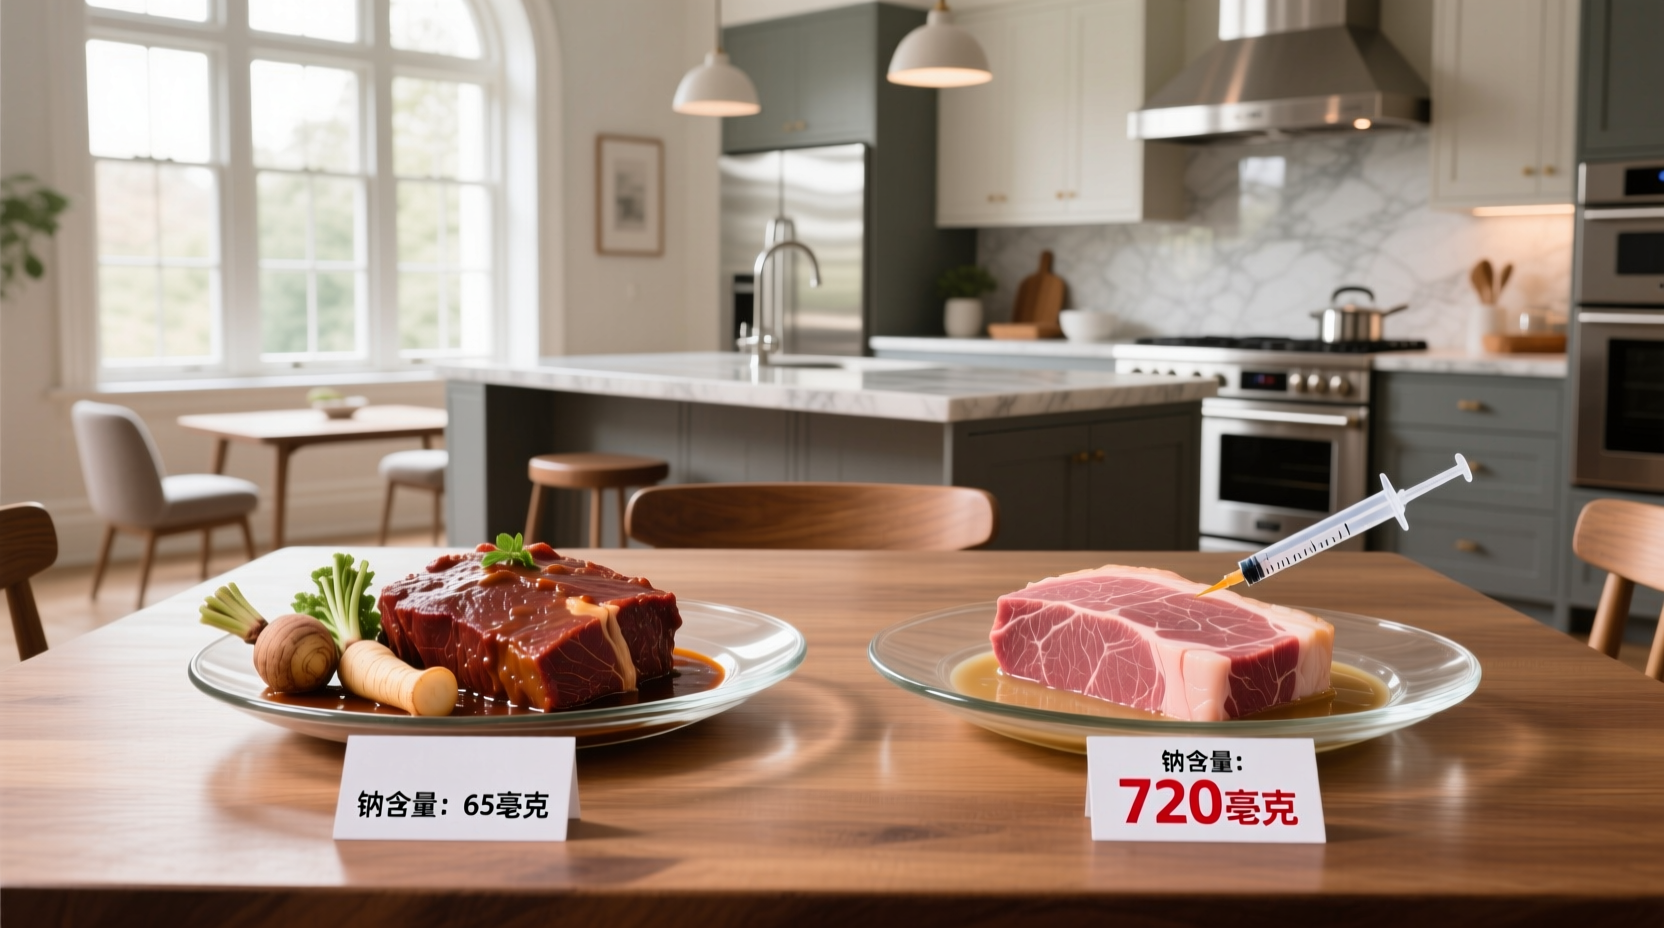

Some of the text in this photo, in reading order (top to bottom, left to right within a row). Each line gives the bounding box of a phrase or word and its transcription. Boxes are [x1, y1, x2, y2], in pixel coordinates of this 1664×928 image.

[1161, 749, 1243, 773] 钠含量：
[357, 789, 550, 819] 钠含量：65毫克
[1118, 778, 1299, 827] 720毫克
